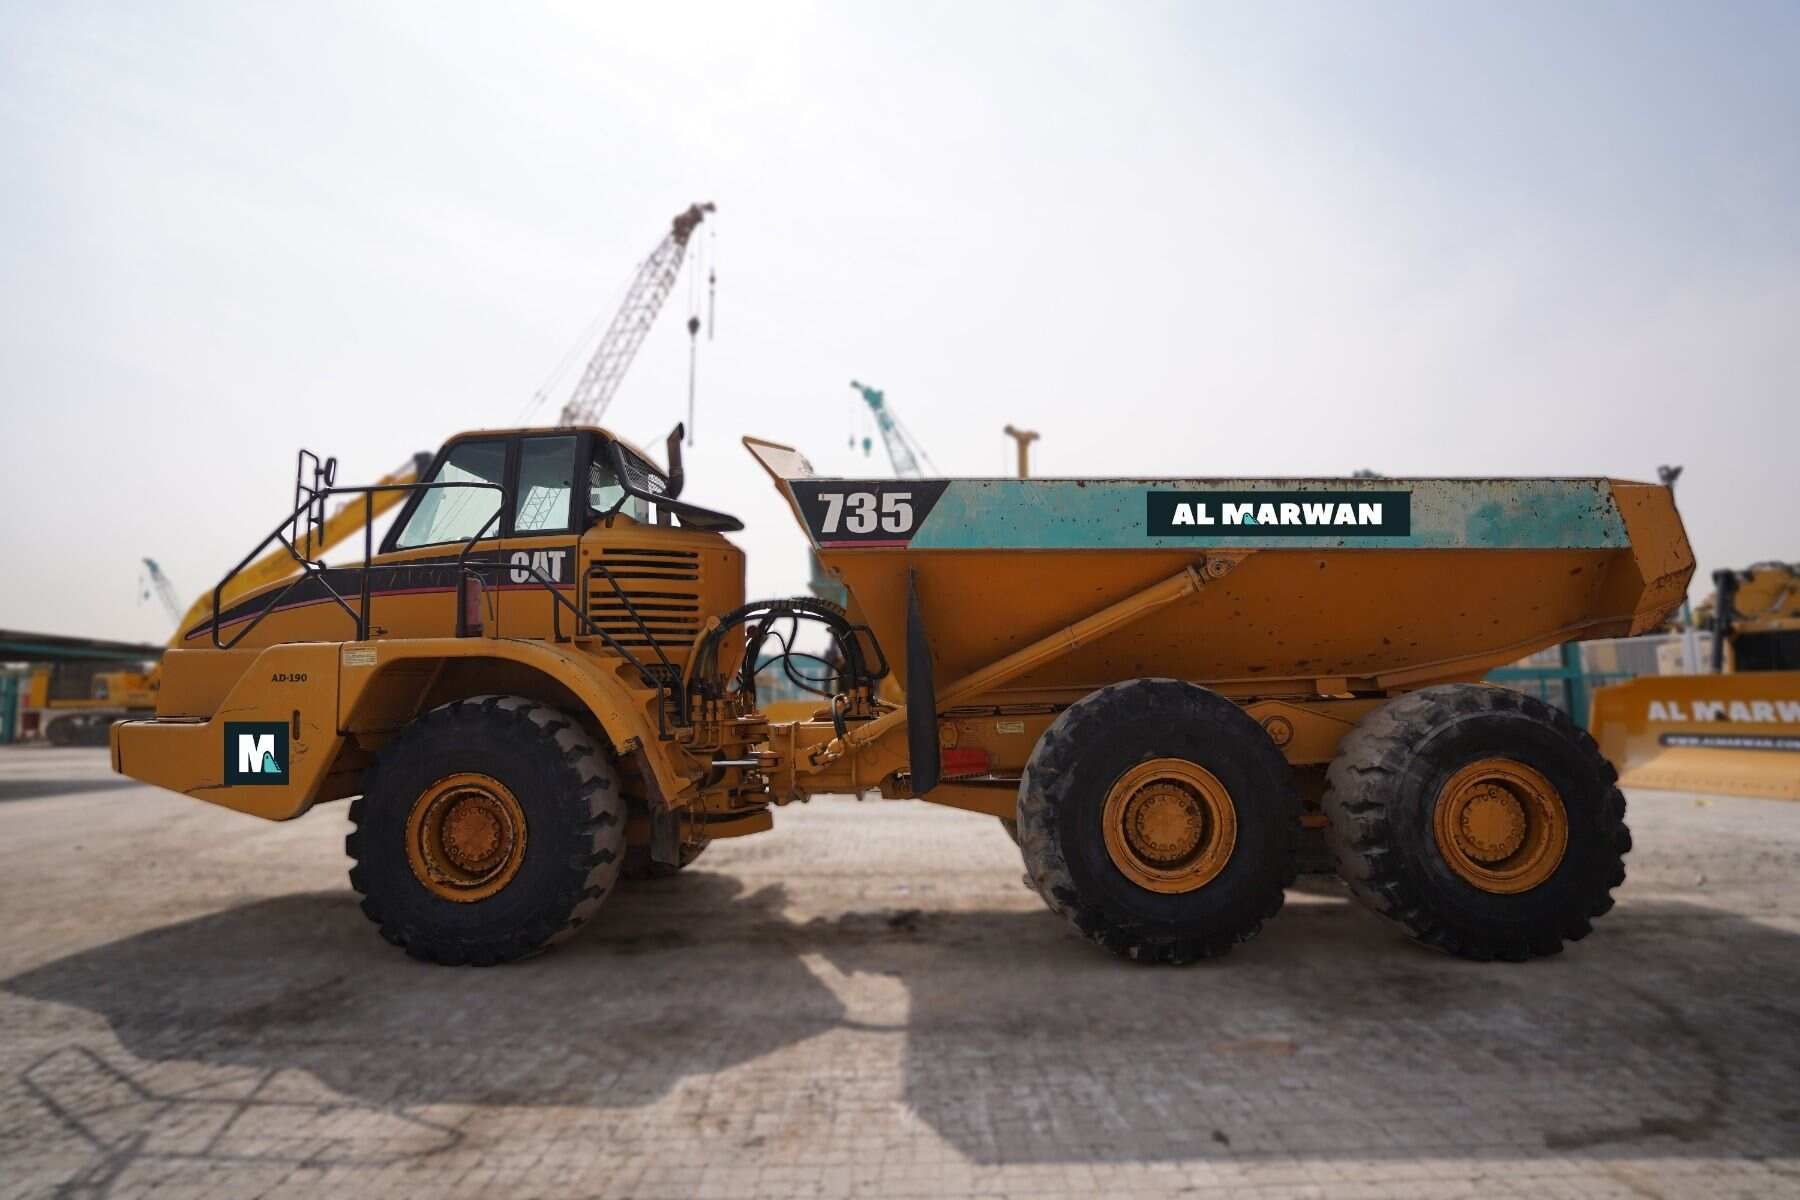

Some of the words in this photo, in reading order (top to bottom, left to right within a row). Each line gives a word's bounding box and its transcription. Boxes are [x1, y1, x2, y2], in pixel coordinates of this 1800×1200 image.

[818, 492, 913, 534] 735
[1172, 503, 1215, 525] AL
[1222, 503, 1383, 525] MARWAN
[510, 551, 566, 583] CAT
[271, 673, 308, 682] AD-190
[1649, 701, 1687, 721] AL
